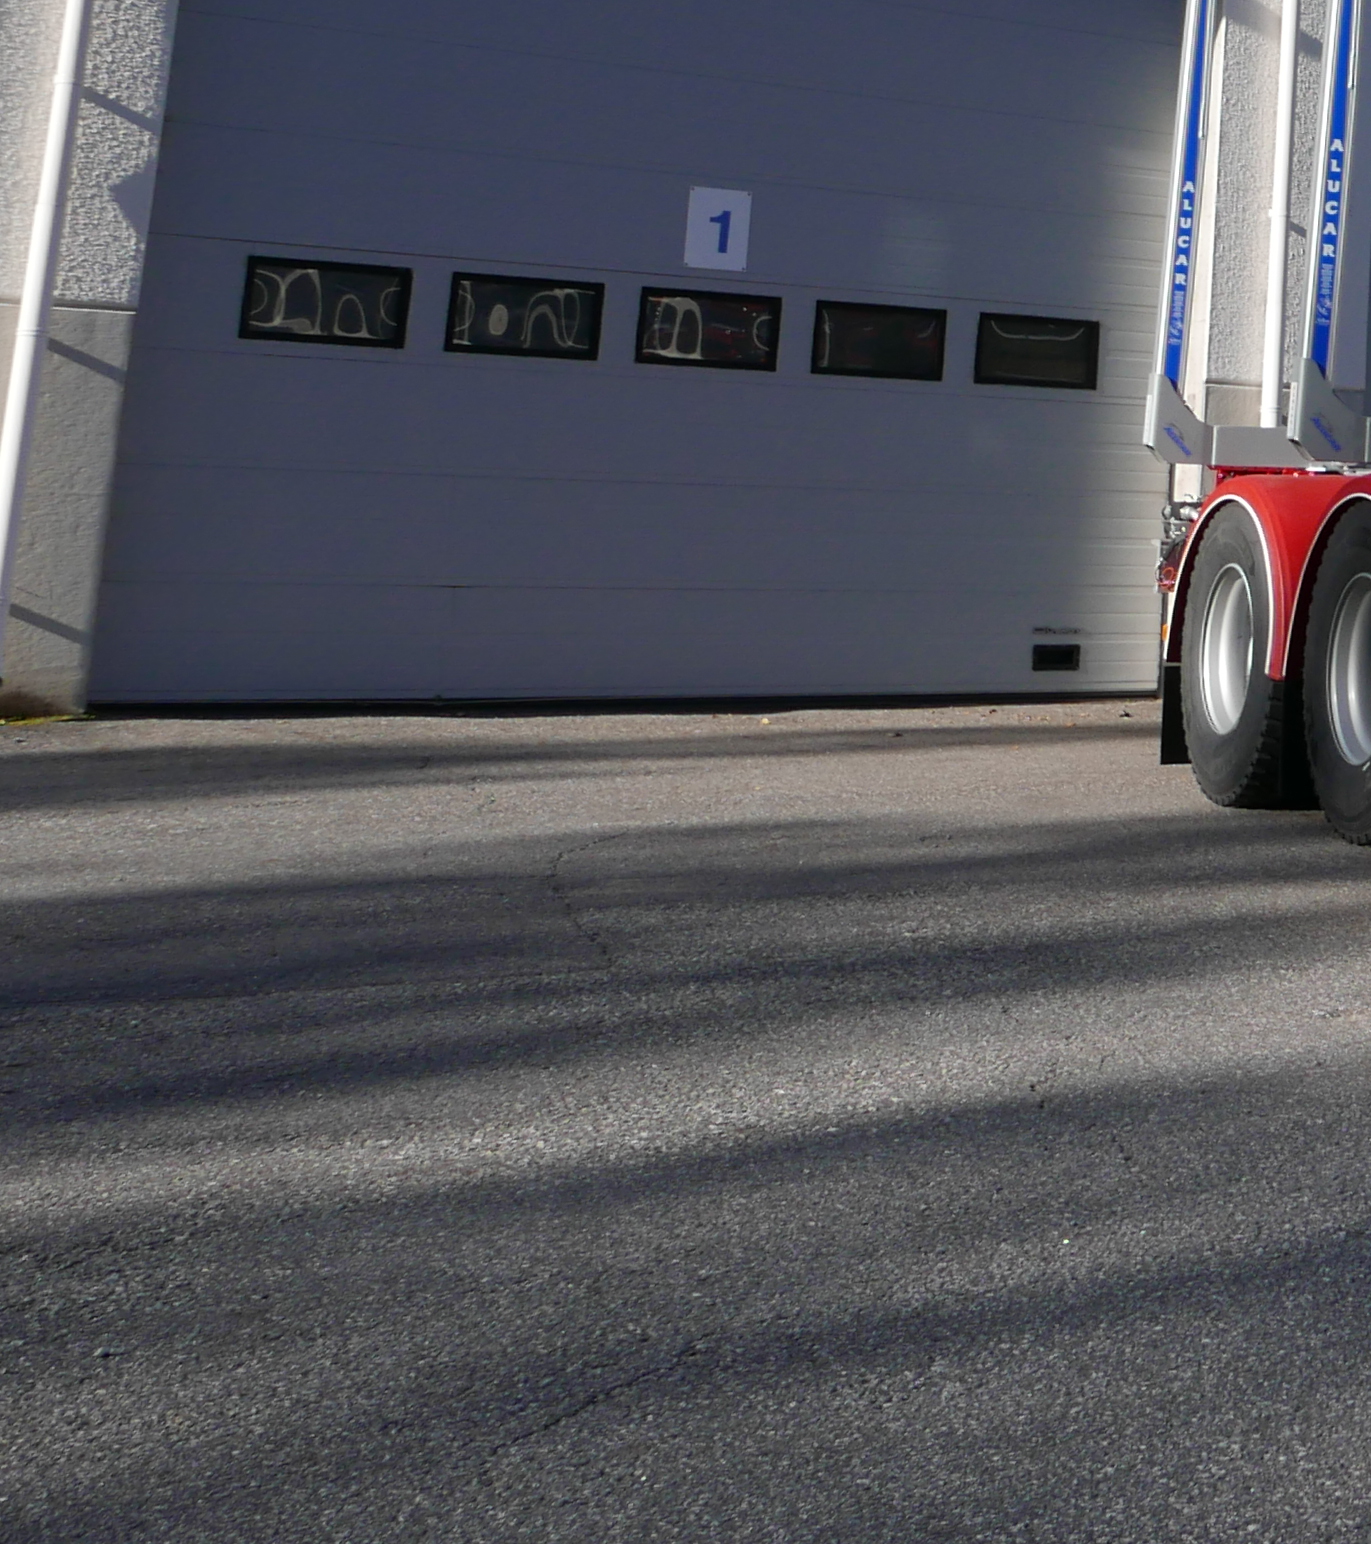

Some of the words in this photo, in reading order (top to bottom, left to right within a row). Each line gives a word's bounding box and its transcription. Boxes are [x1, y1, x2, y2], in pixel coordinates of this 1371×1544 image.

[709, 210, 731, 253] 1
[1175, 180, 1195, 286] ALUCAR
[1322, 138, 1344, 257] ALUCAR
